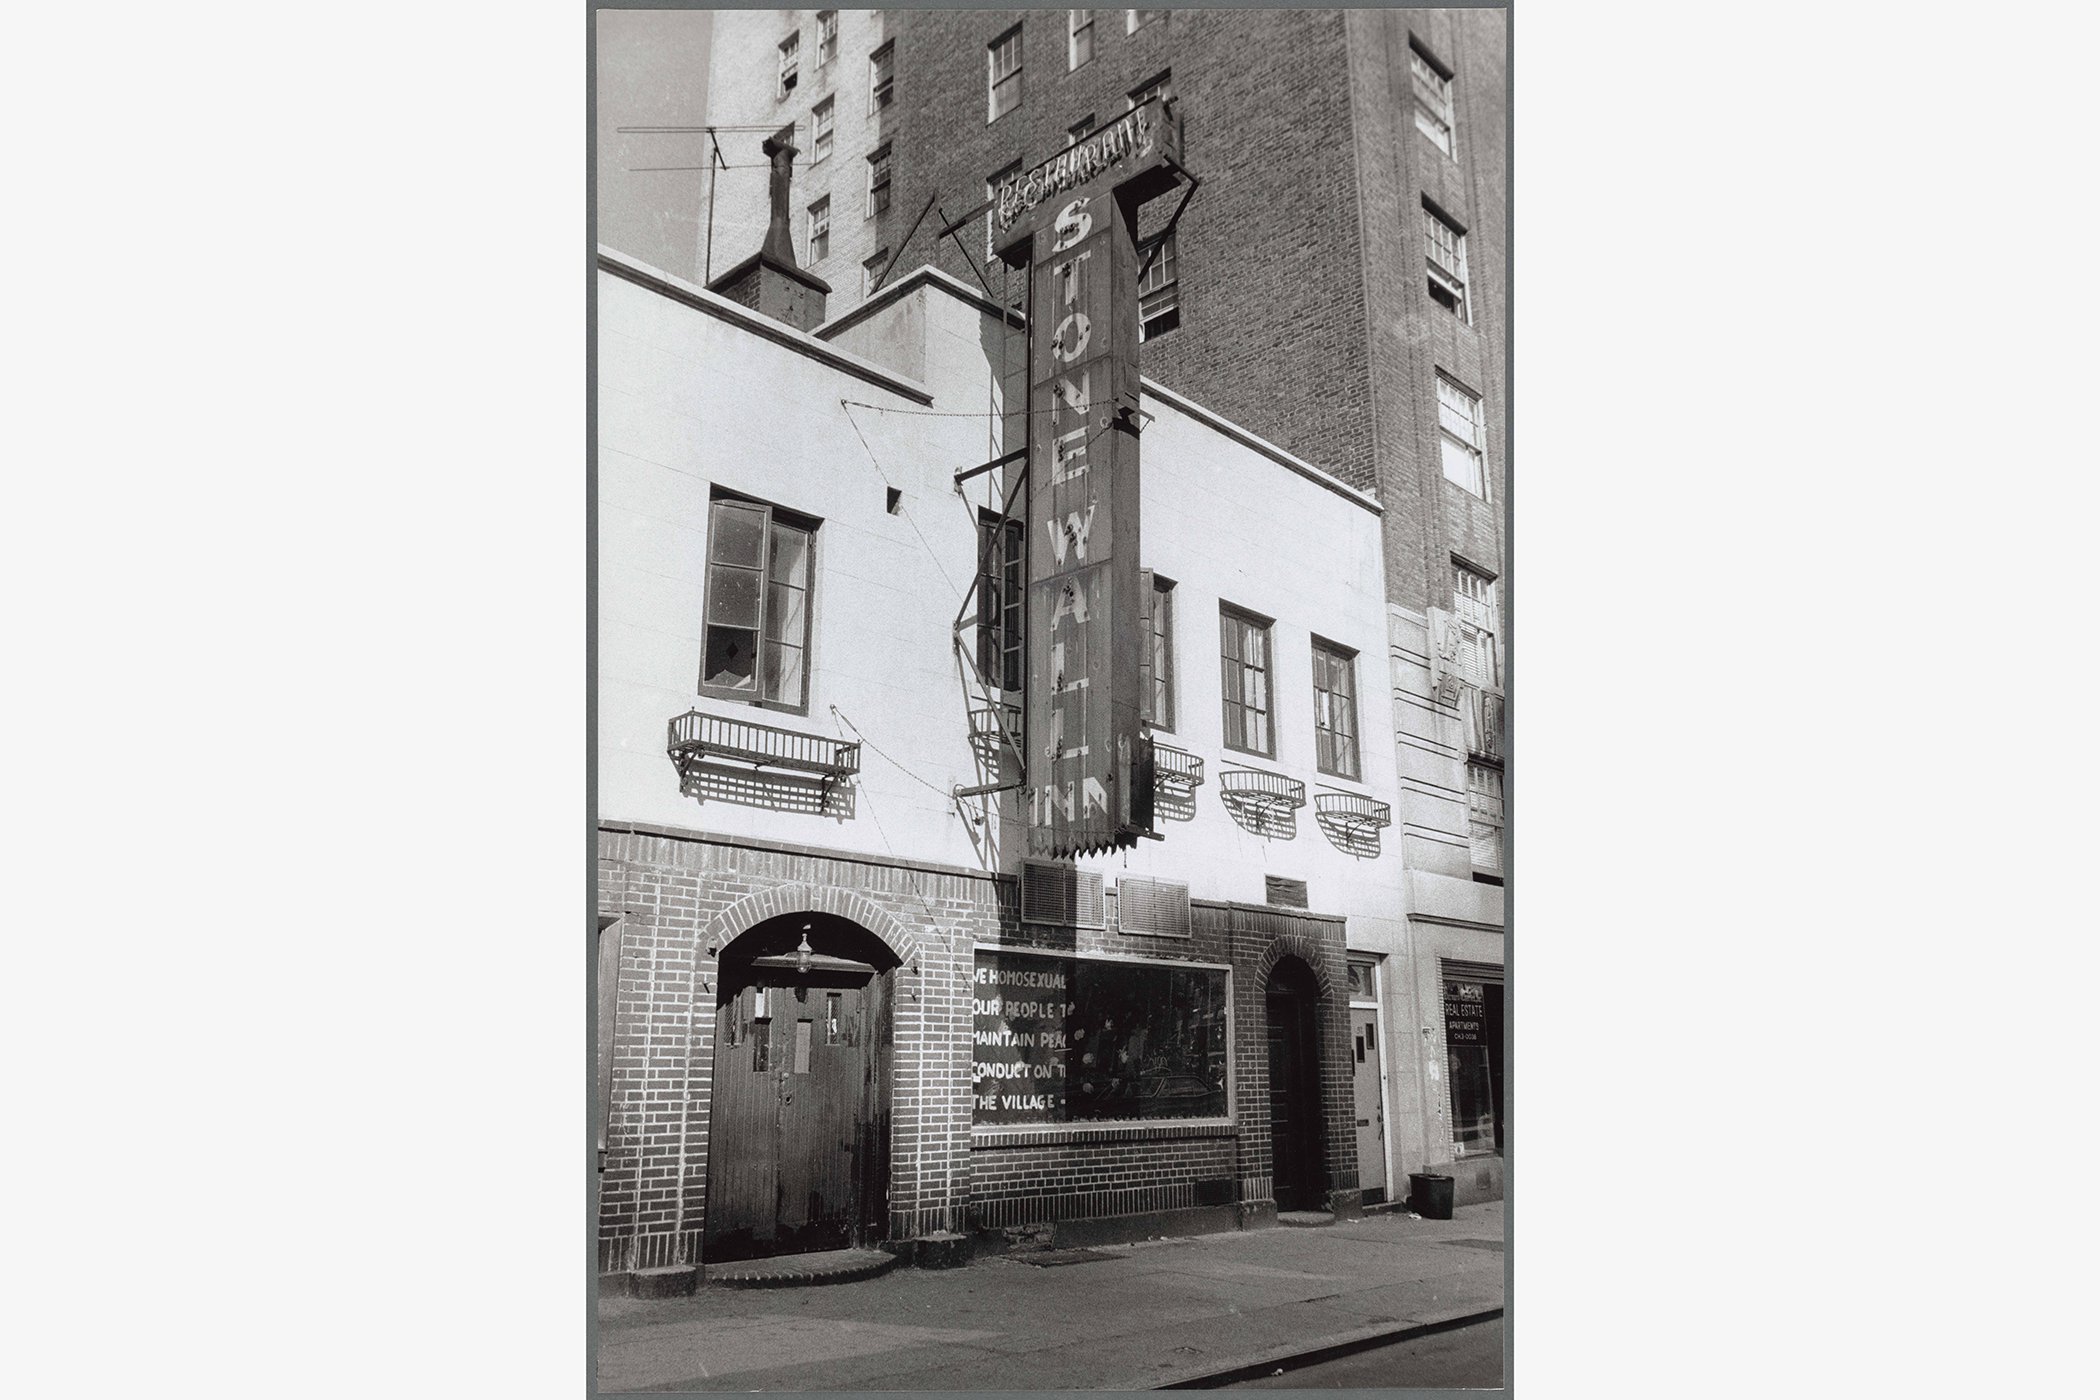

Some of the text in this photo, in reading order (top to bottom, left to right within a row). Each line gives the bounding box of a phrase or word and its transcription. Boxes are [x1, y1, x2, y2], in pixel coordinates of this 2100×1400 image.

[999, 106, 1153, 232] RESTAURANT
[1028, 776, 1108, 828] INN
[972, 998, 1000, 1016] OUR
[1005, 1001, 1055, 1019] PEOPLE
[1445, 1003, 1483, 1017] REAL ESTATE
[1449, 1021, 1479, 1031] APARTMENTS
[972, 1030, 1035, 1047] MAINTAIN
[972, 1061, 1032, 1079] CONDUCT
[1034, 1063, 1052, 1079] ON
[972, 1094, 997, 1111] THE
[1001, 1095, 1055, 1110] VILLAGE
